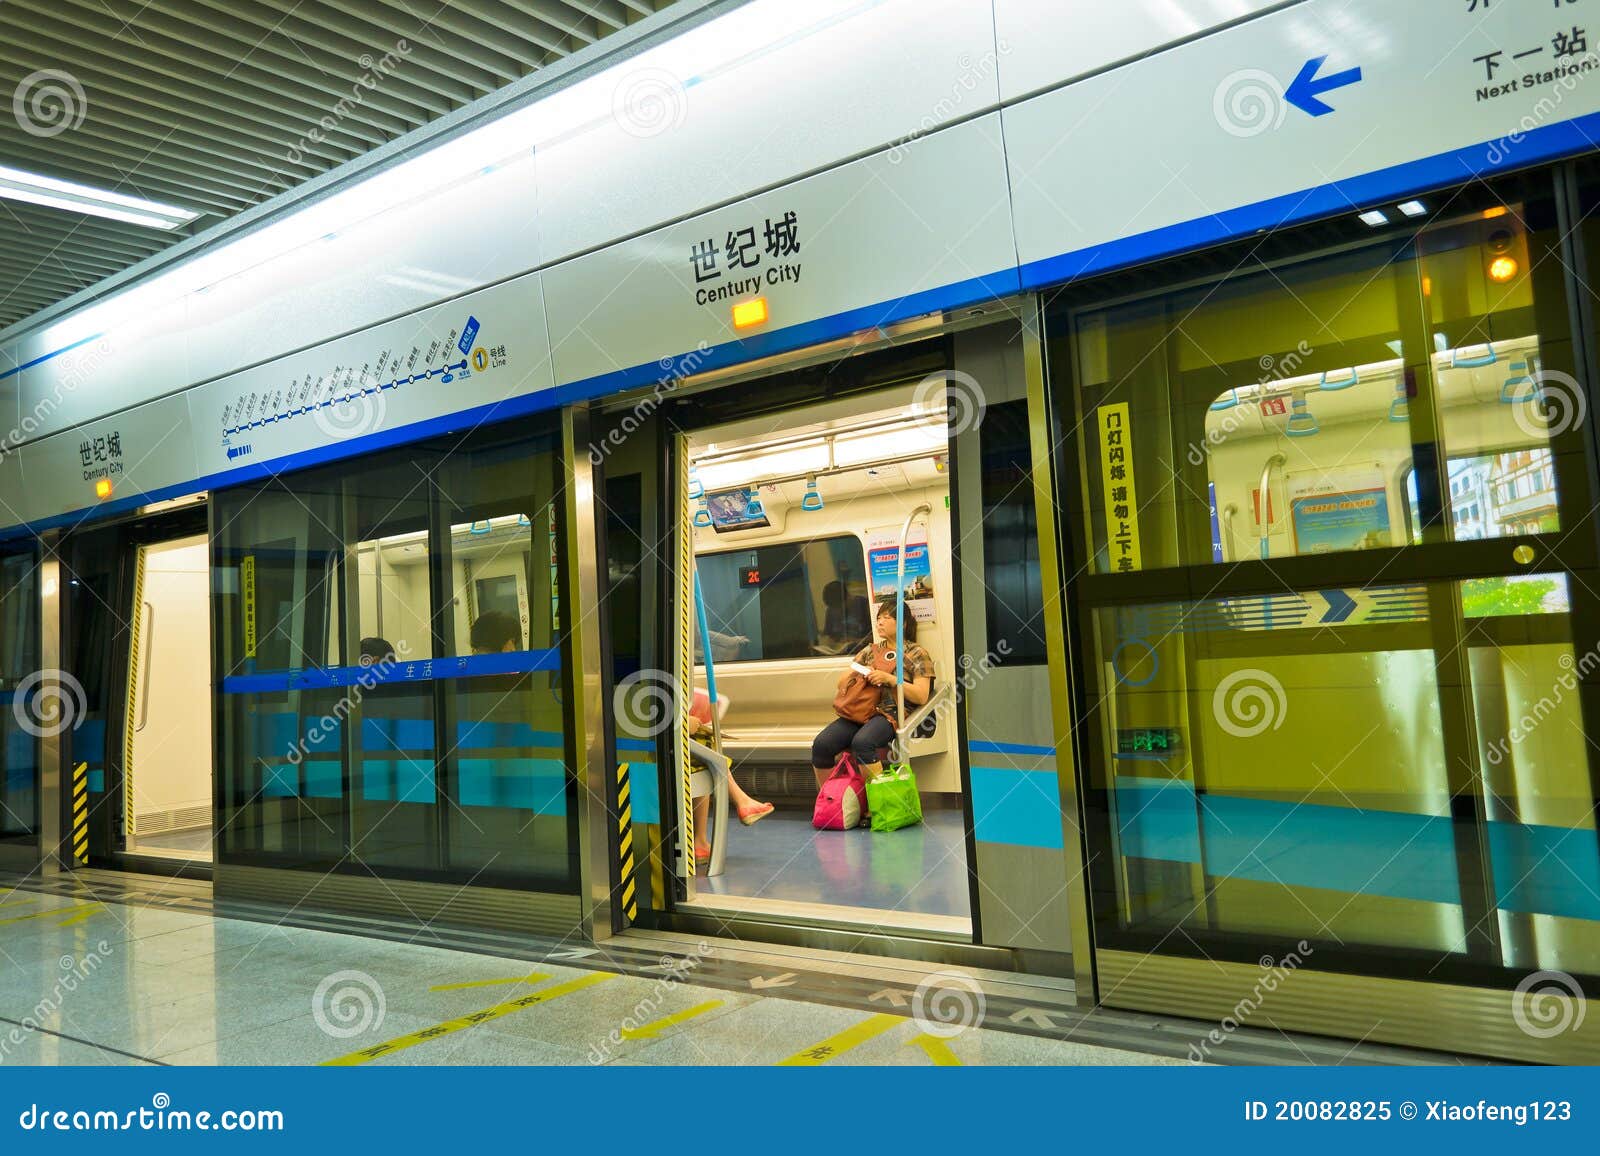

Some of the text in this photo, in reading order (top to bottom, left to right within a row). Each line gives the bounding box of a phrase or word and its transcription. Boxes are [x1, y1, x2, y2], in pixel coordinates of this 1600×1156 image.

[1473, 26, 1587, 81] 下一站
[1476, 58, 1600, 102] Next Station:
[689, 210, 801, 283] 世纪城
[695, 263, 801, 306] Century City
[490, 344, 506, 358] 号线
[492, 359, 506, 368] Line
[80, 431, 122, 467] 世纪城
[1106, 412, 1126, 481] 门灯闪烁
[83, 461, 124, 481] Century City
